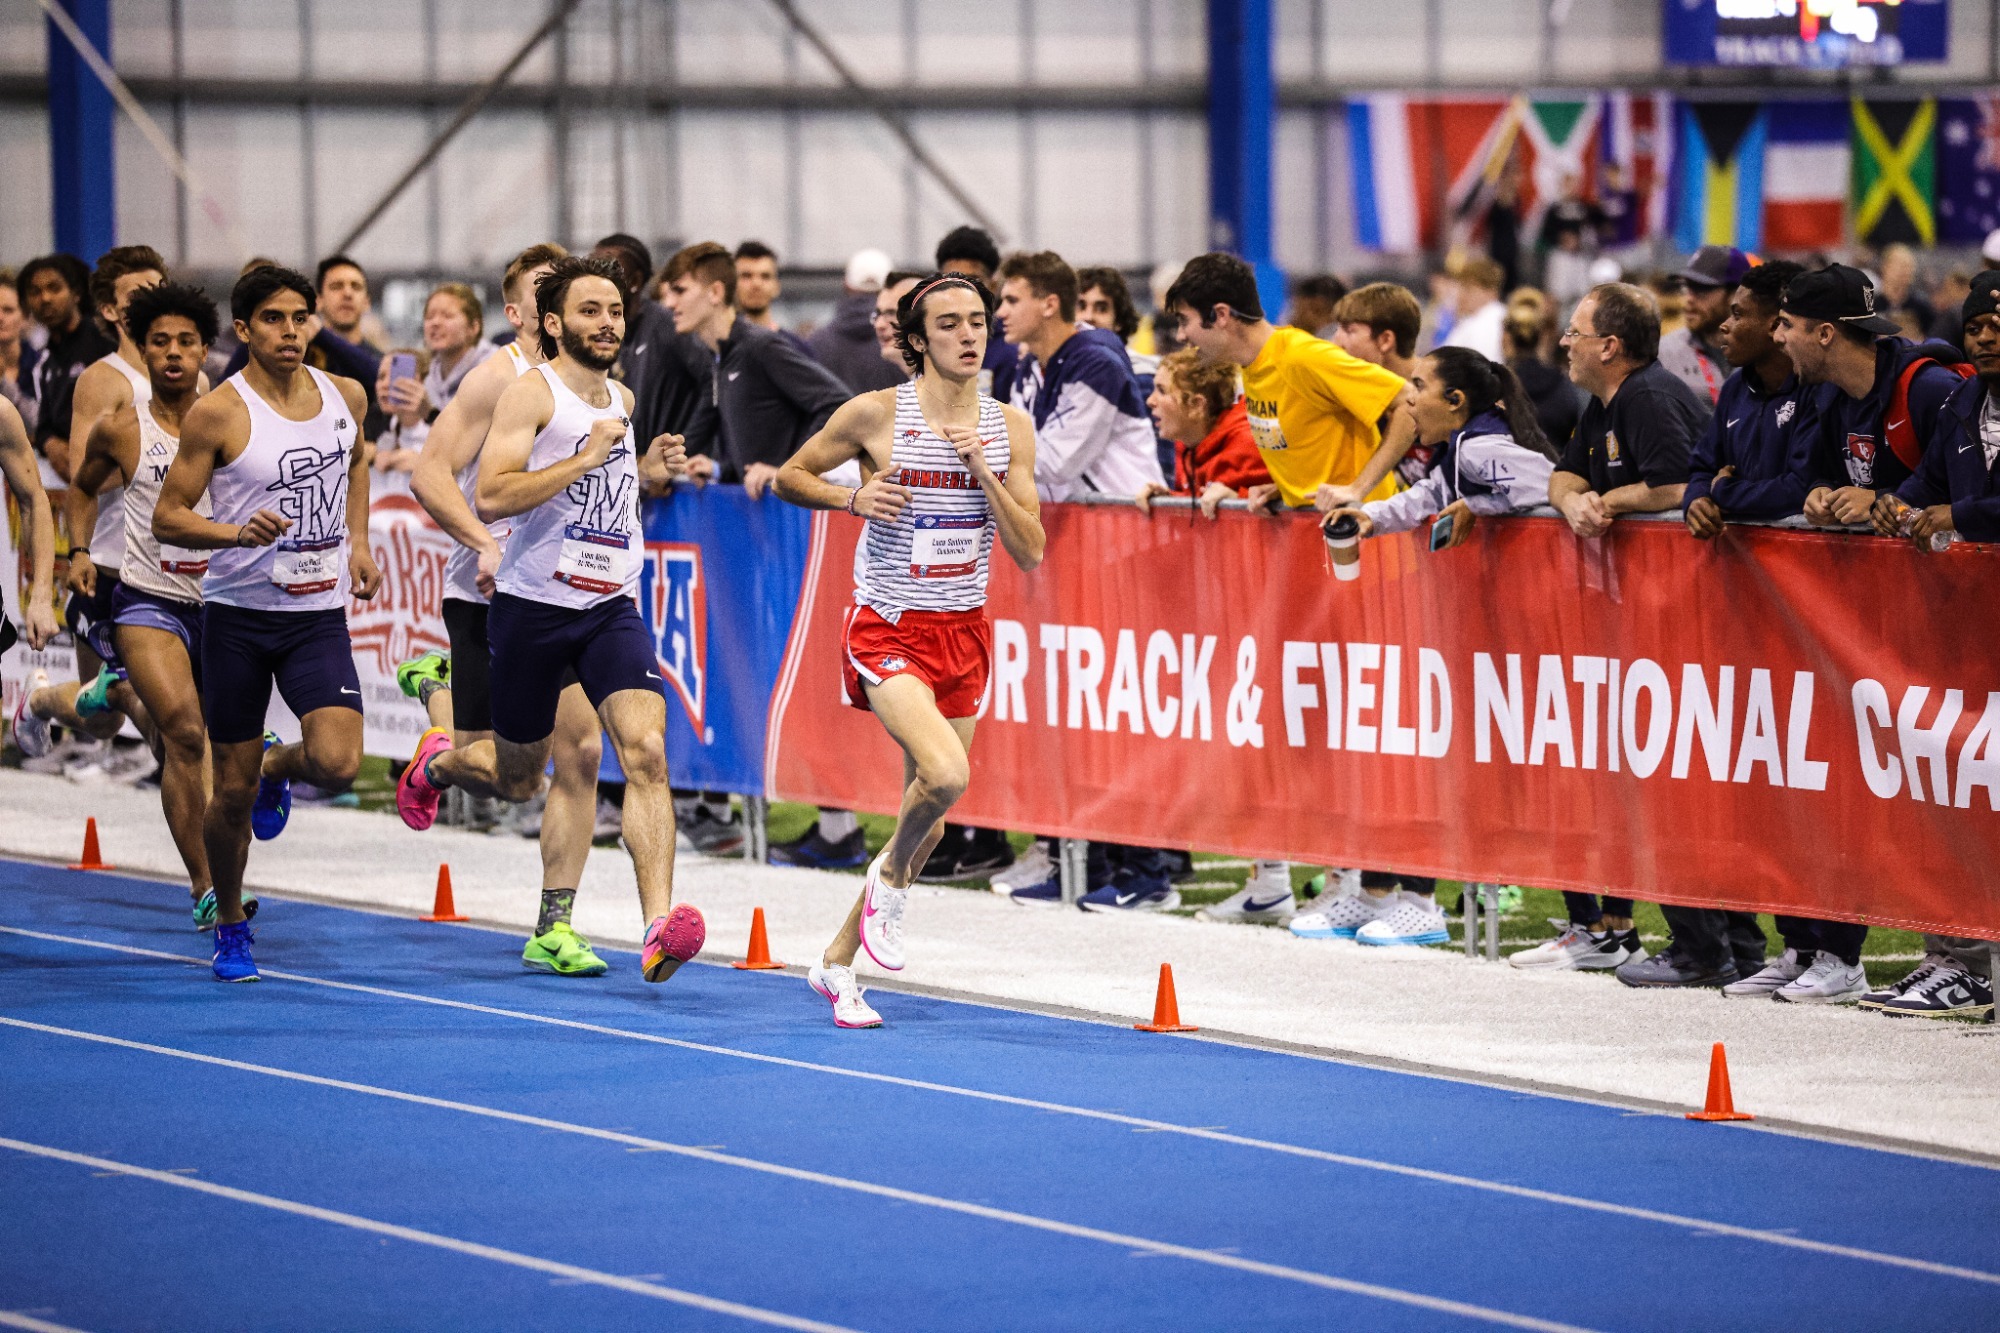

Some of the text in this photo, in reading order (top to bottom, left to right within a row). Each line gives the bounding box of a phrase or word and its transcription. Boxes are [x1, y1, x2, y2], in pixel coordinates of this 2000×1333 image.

[1040, 623, 1218, 741] TRACK
[1226, 635, 1264, 748] &
[1282, 640, 1452, 758] FIELD
[1473, 652, 1829, 791] NATIONAL
